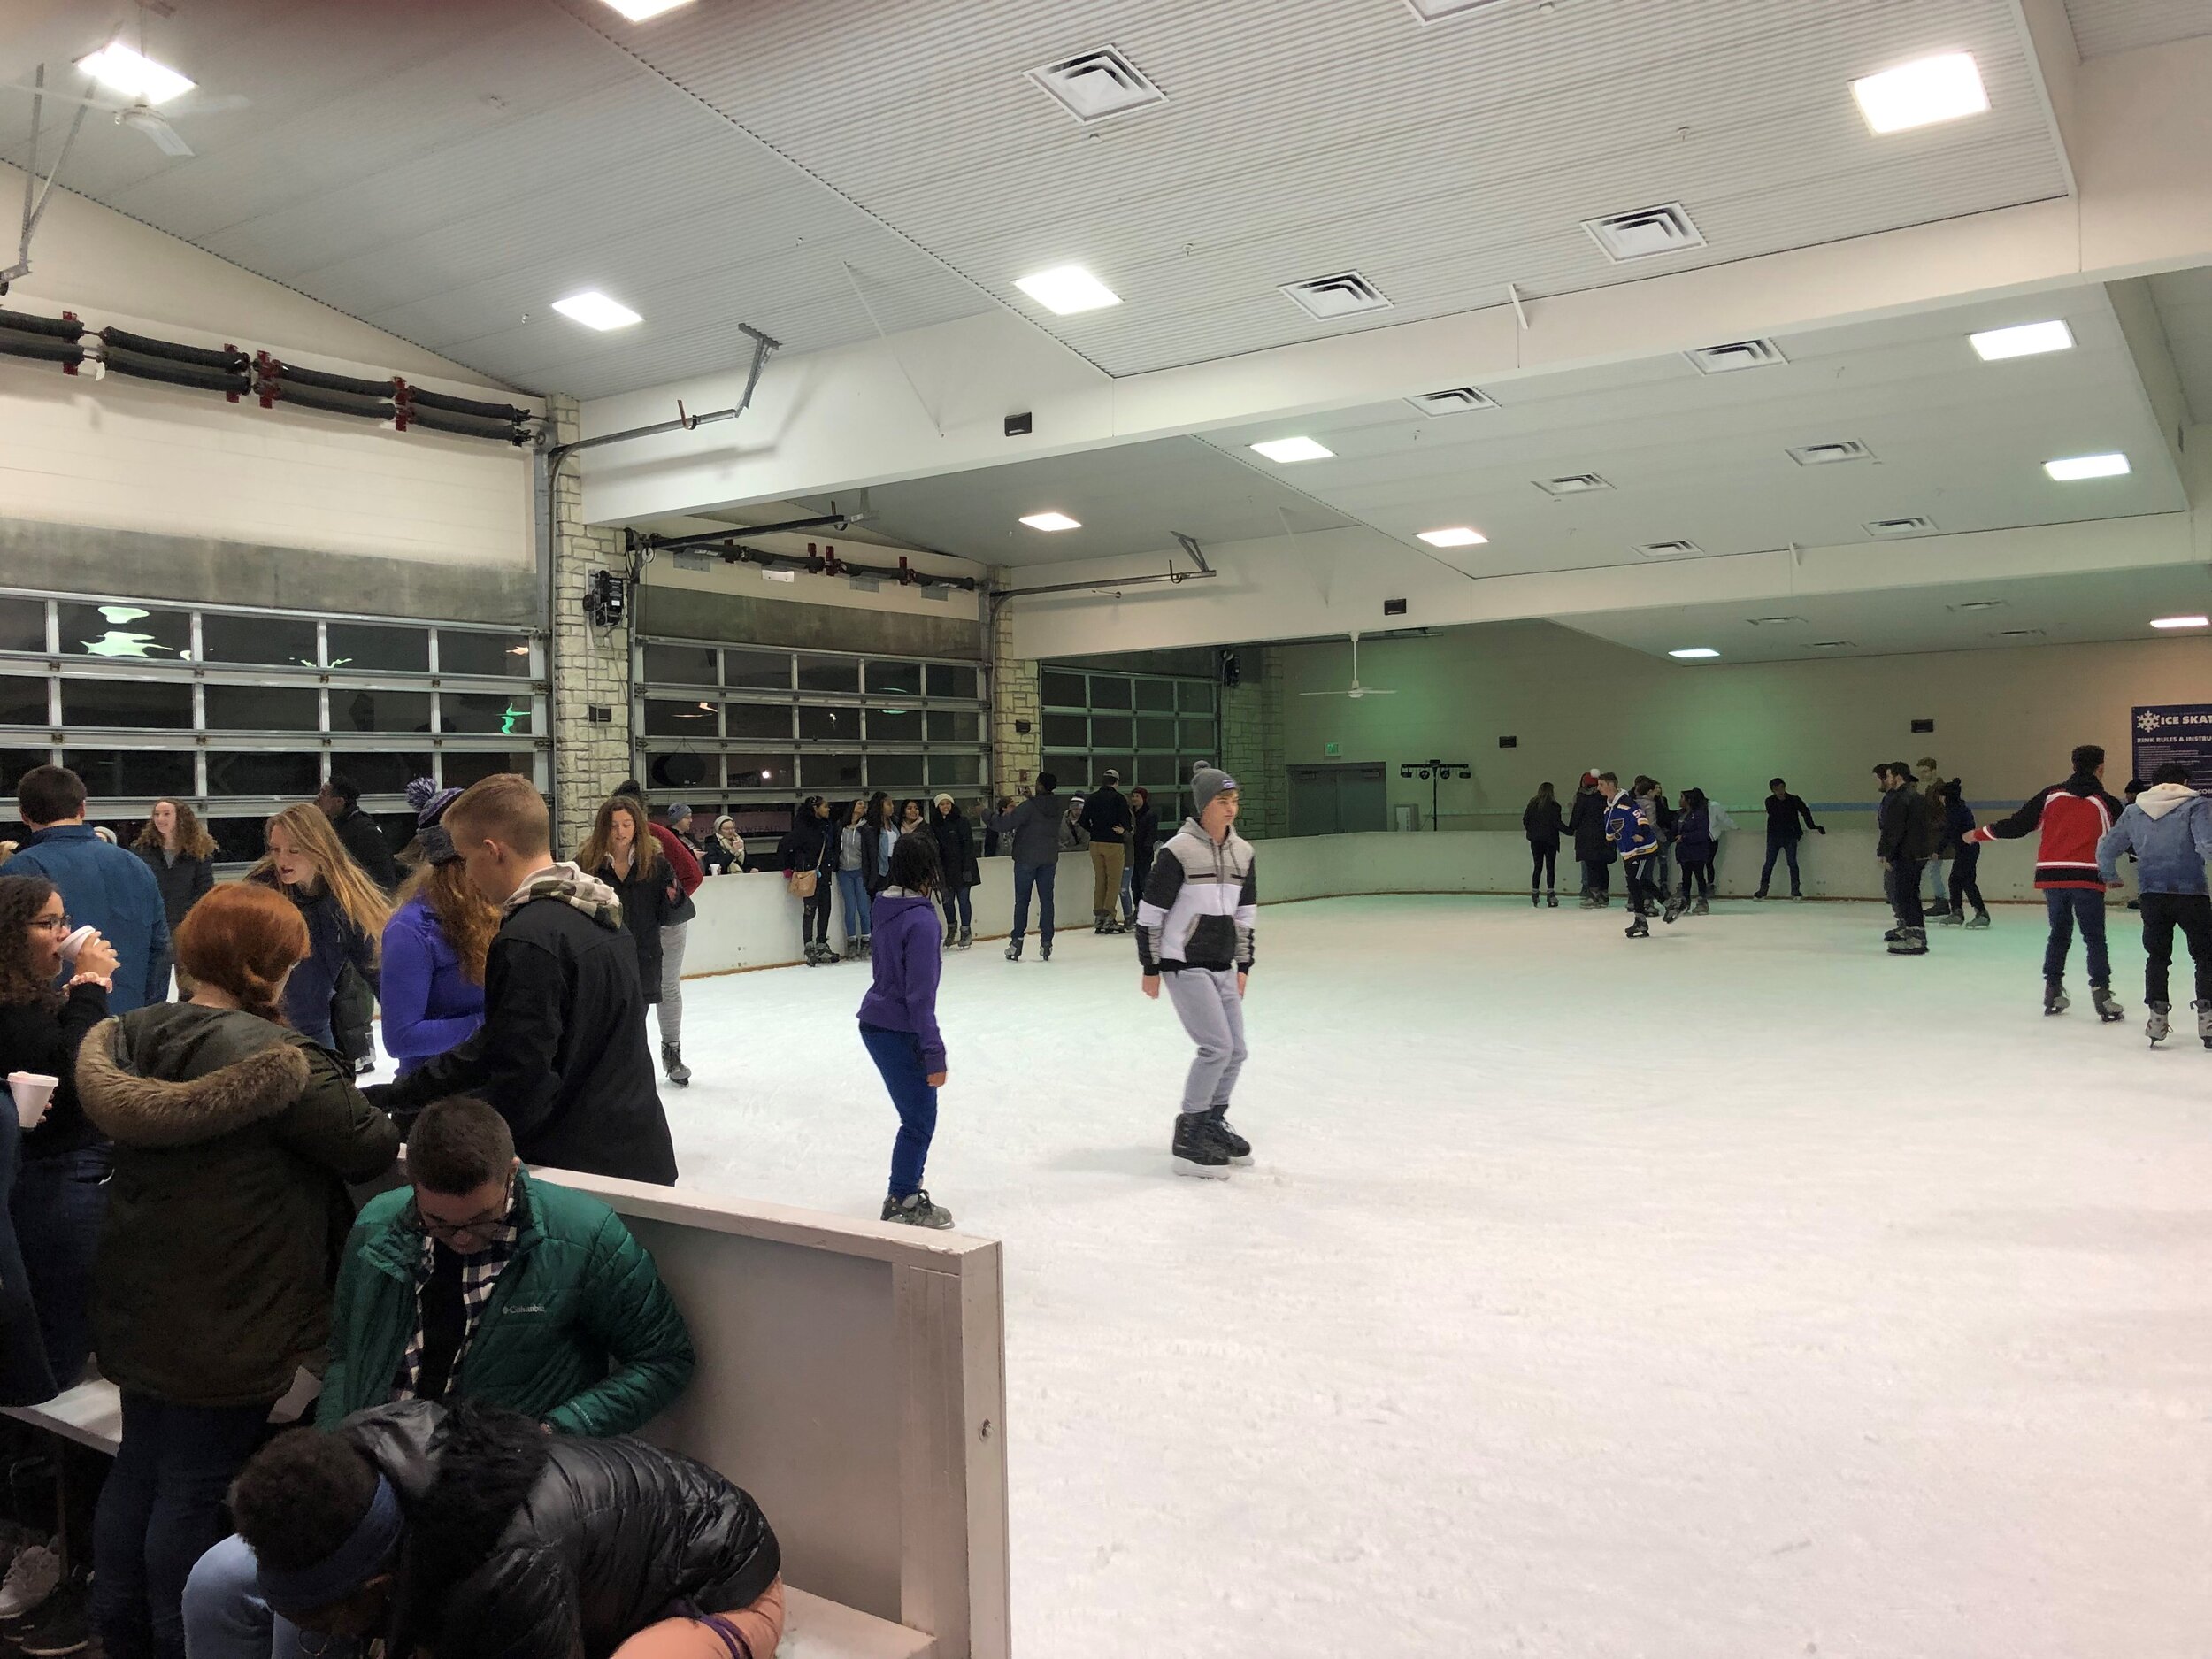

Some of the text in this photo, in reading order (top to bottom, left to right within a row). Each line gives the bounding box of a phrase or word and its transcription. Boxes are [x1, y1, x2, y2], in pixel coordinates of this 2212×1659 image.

[2161, 715, 2212, 725] ICE SKAT
[509, 1303, 545, 1314] Columbia
